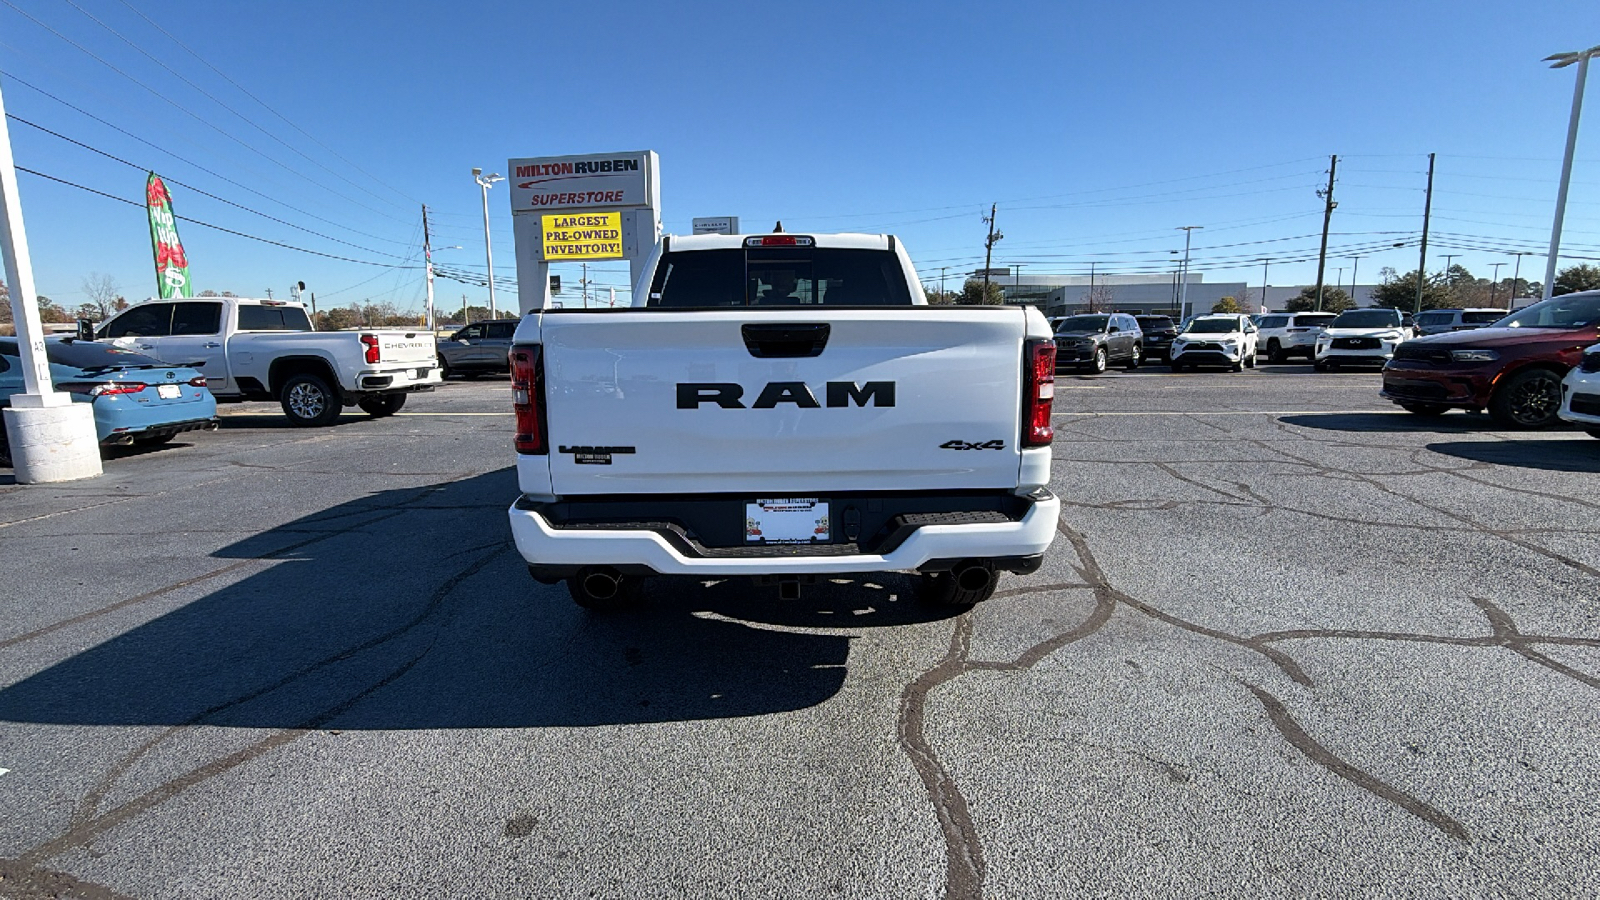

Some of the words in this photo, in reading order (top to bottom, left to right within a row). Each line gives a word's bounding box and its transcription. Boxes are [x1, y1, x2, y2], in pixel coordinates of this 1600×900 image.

[531, 190, 624, 206] SUPERSTORE
[554, 216, 609, 227] LARGEST
[546, 229, 619, 241] PRE-OWNED
[546, 243, 620, 255] INVENTORY!
[676, 381, 896, 409] RAM
[938, 439, 1007, 450] 4x4
